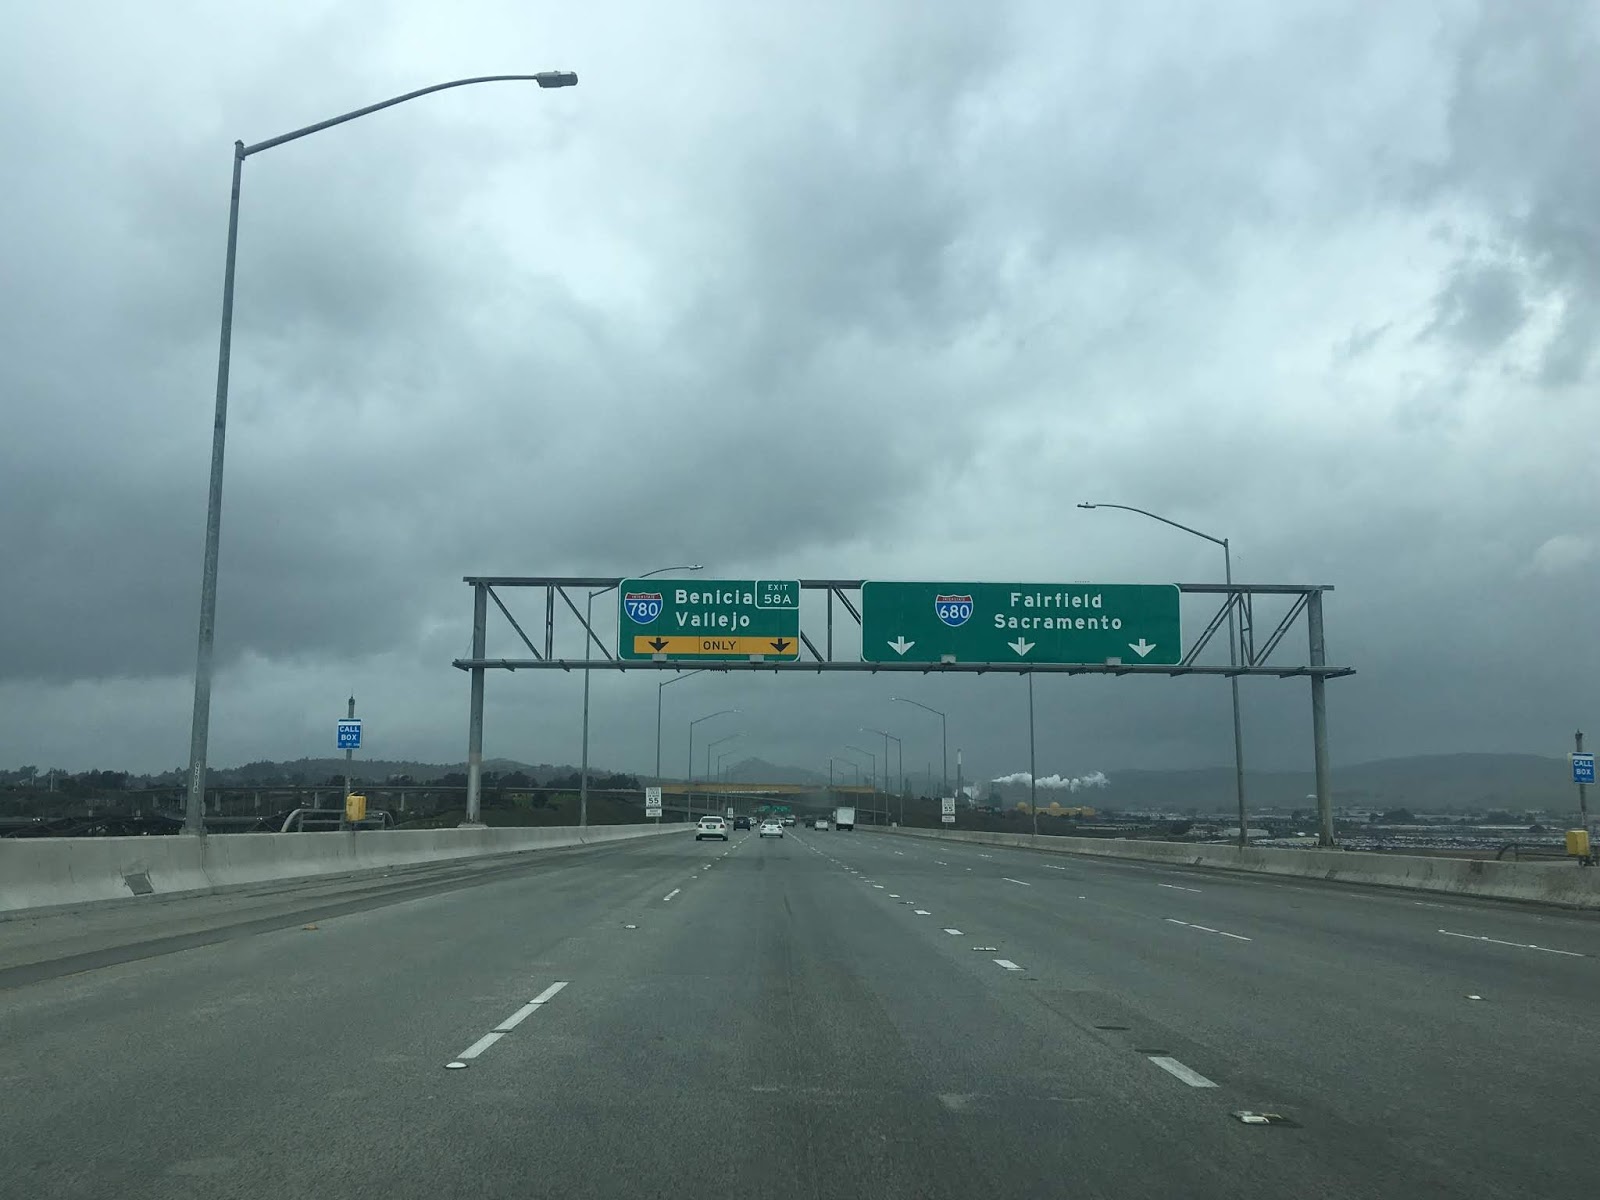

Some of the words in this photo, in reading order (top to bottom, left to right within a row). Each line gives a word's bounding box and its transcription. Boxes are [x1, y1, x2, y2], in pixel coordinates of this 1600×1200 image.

[675, 589, 753, 604] Benicia
[764, 594, 792, 604] 58A
[1010, 592, 1102, 608] Fairfield
[628, 602, 659, 616] 780
[940, 604, 969, 619] 680
[675, 611, 750, 631] Vallejo
[994, 613, 1122, 630] Sacramento
[703, 640, 736, 650] ONLY
[340, 733, 357, 741] BOX
